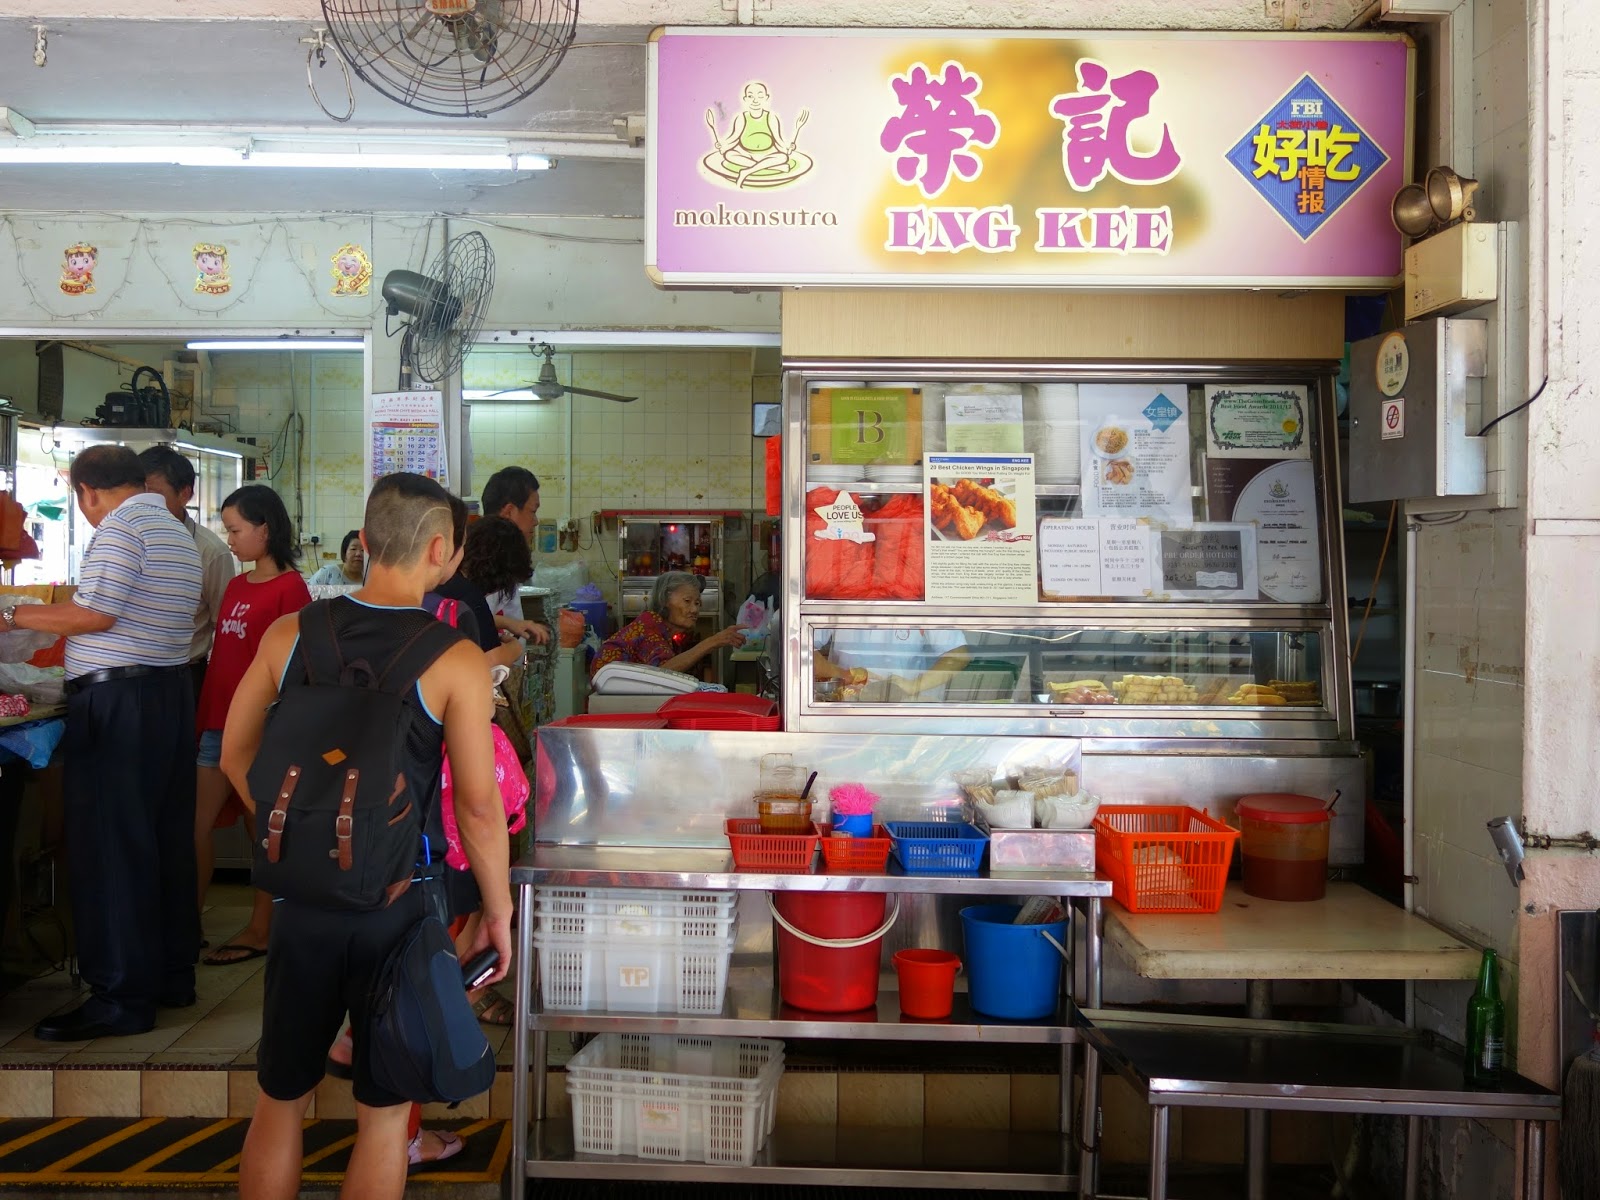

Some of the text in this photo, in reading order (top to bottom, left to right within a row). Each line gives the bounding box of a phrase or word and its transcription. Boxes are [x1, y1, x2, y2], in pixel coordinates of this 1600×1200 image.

[1291, 102, 1323, 114] FBI
[881, 62, 1181, 196] 榮記
[1253, 124, 1361, 180] 好吃
[1298, 166, 1326, 214] 情报
[675, 204, 838, 226] makansutra
[888, 209, 1172, 252] ENG KEE
[854, 410, 885, 444] B
[231, 601, 240, 616] I
[621, 968, 648, 985] TP
